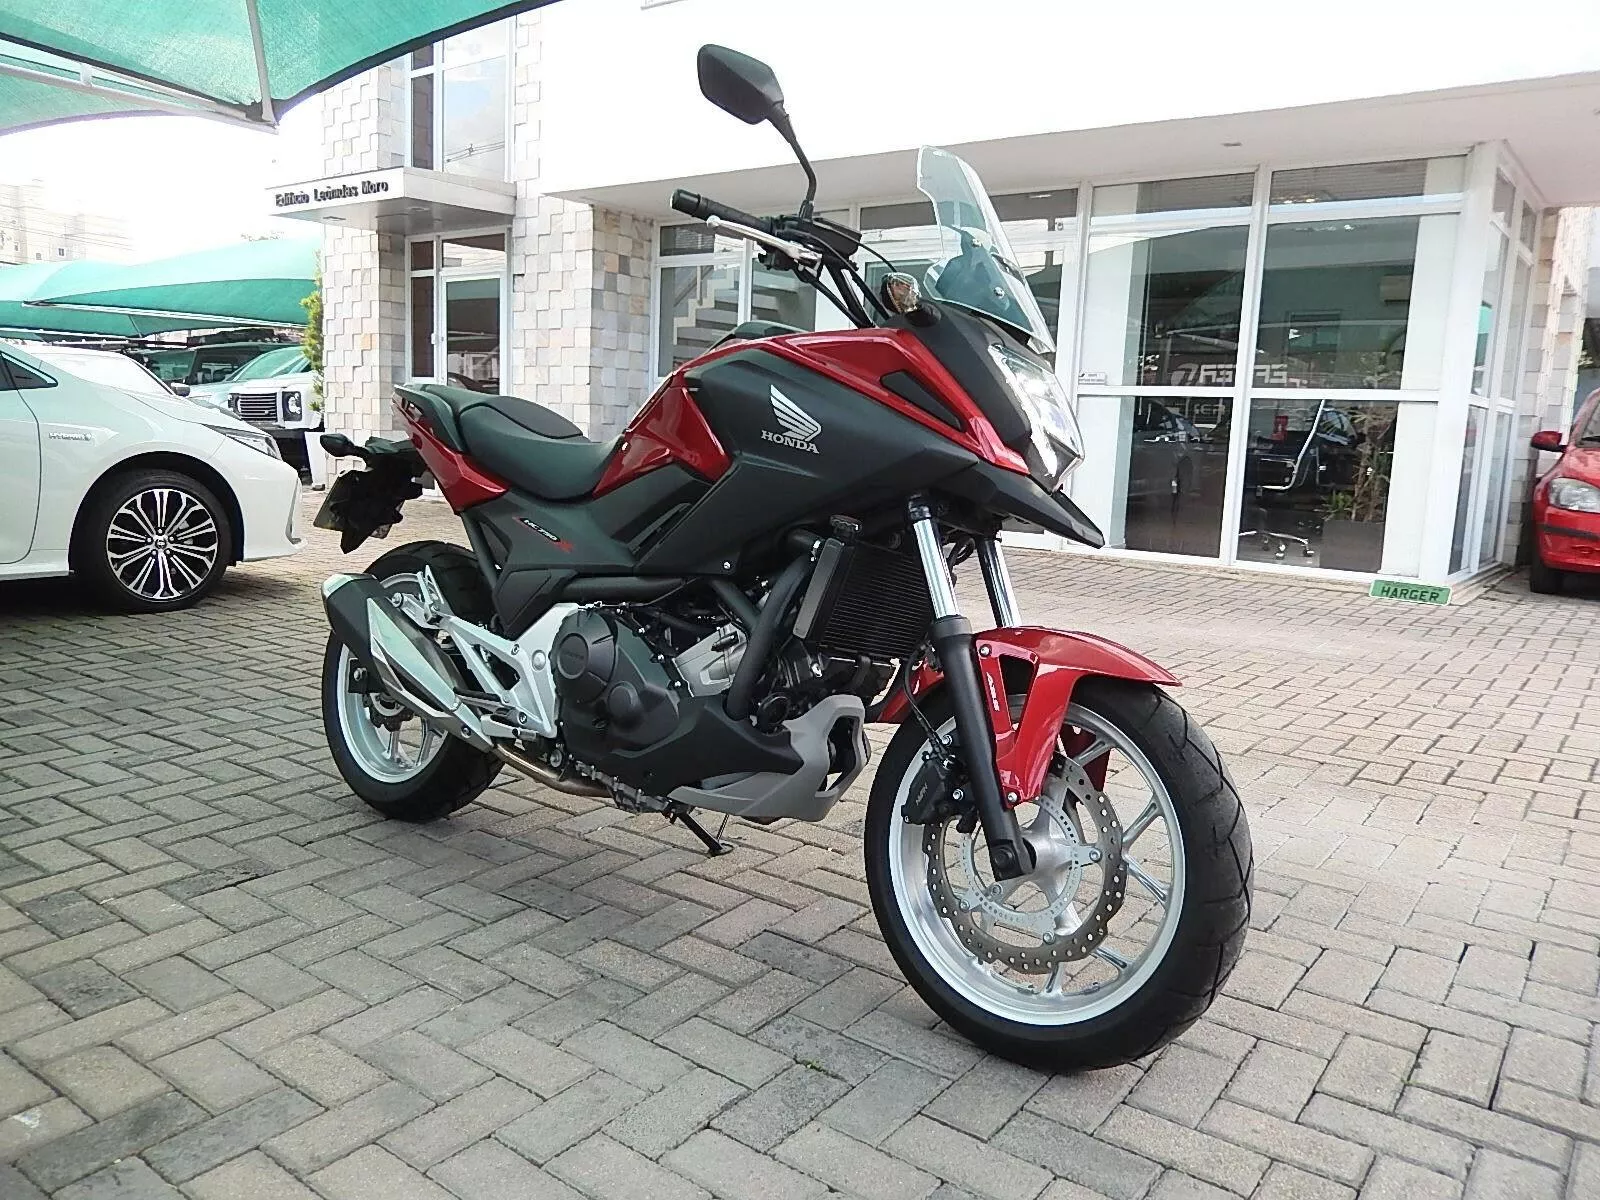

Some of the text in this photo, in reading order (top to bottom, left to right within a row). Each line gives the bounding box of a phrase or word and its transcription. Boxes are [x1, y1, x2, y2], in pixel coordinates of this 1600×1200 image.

[362, 180, 388, 195] Moro
[761, 430, 819, 454] HONDA
[1381, 586, 1440, 601] HARGER
